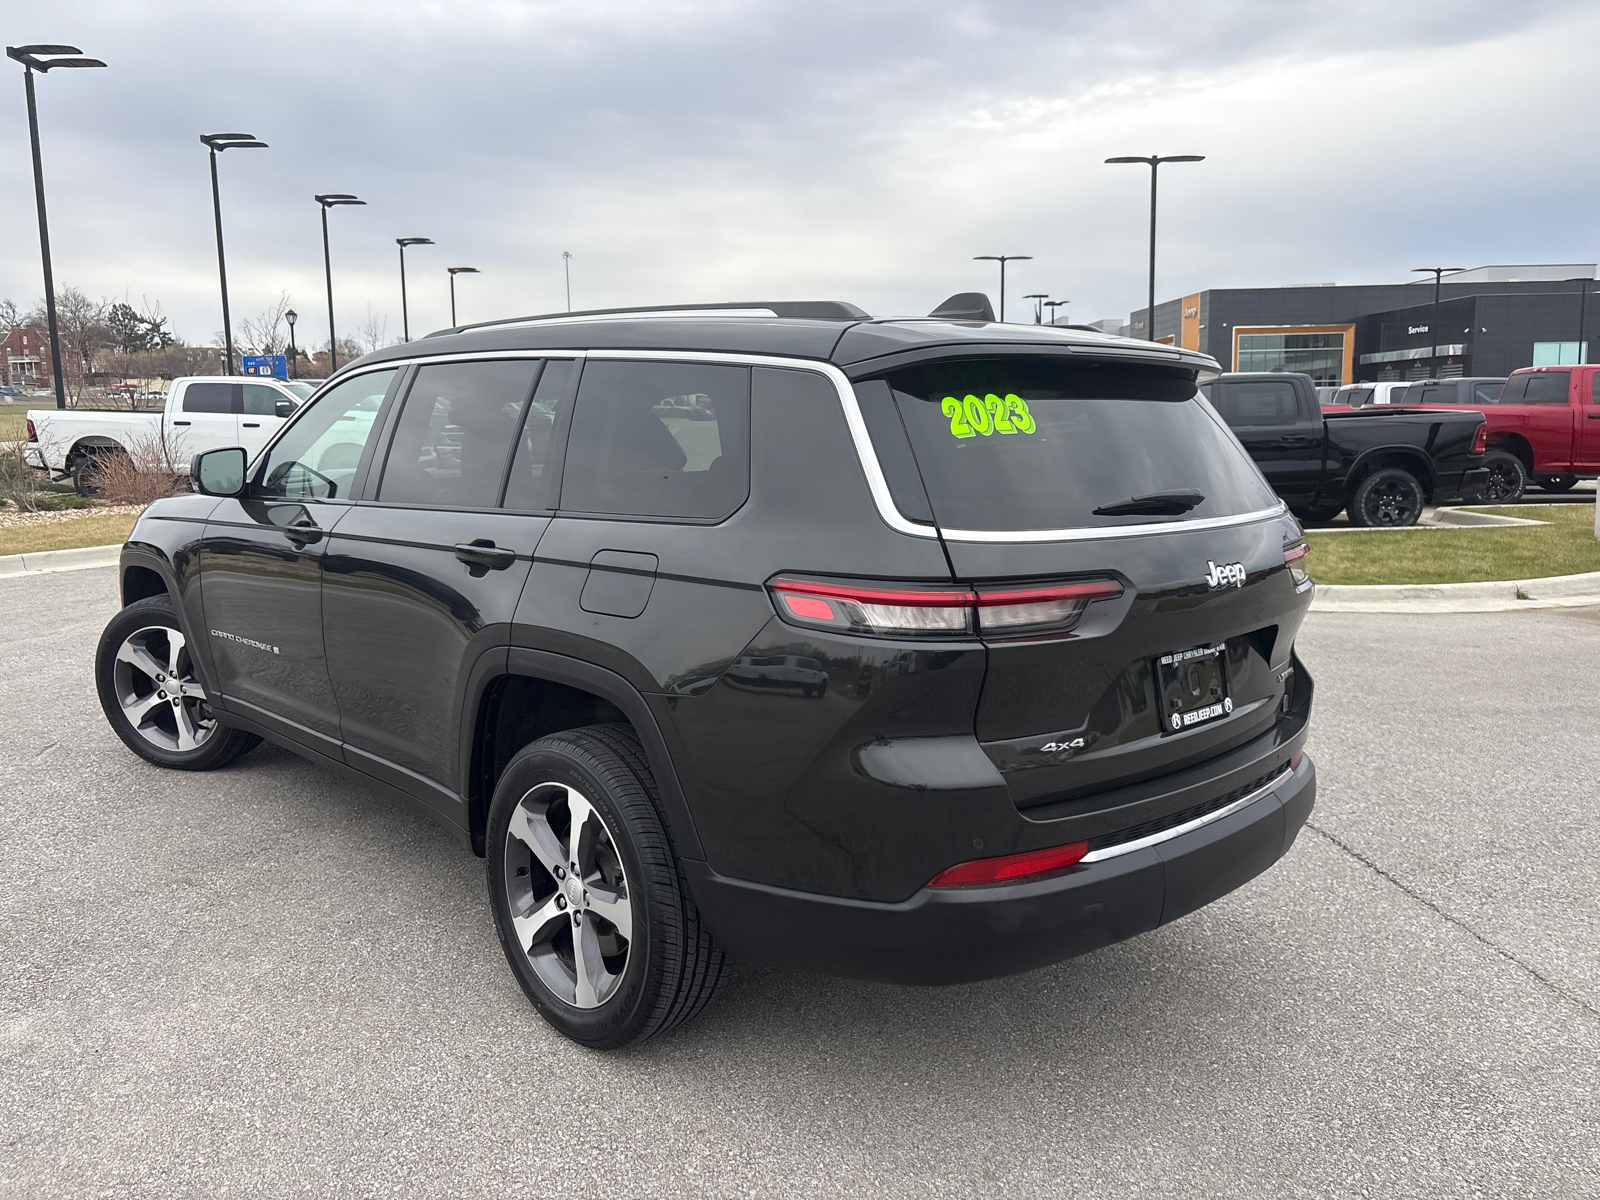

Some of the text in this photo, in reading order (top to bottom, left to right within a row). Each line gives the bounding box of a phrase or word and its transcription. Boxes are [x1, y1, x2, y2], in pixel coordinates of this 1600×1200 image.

[1183, 306, 1197, 318] Jeep
[1408, 325, 1429, 335] Service
[941, 393, 1036, 439] 2023
[1205, 560, 1246, 590] Jeep
[211, 630, 234, 640] GRAND
[236, 636, 272, 652] CHEROKEE
[1173, 652, 1183, 663] JEEP
[1183, 648, 1204, 660] CHRYSLER
[1183, 703, 1223, 726] REEDJEEP.COM
[1040, 737, 1085, 752] 4x4
